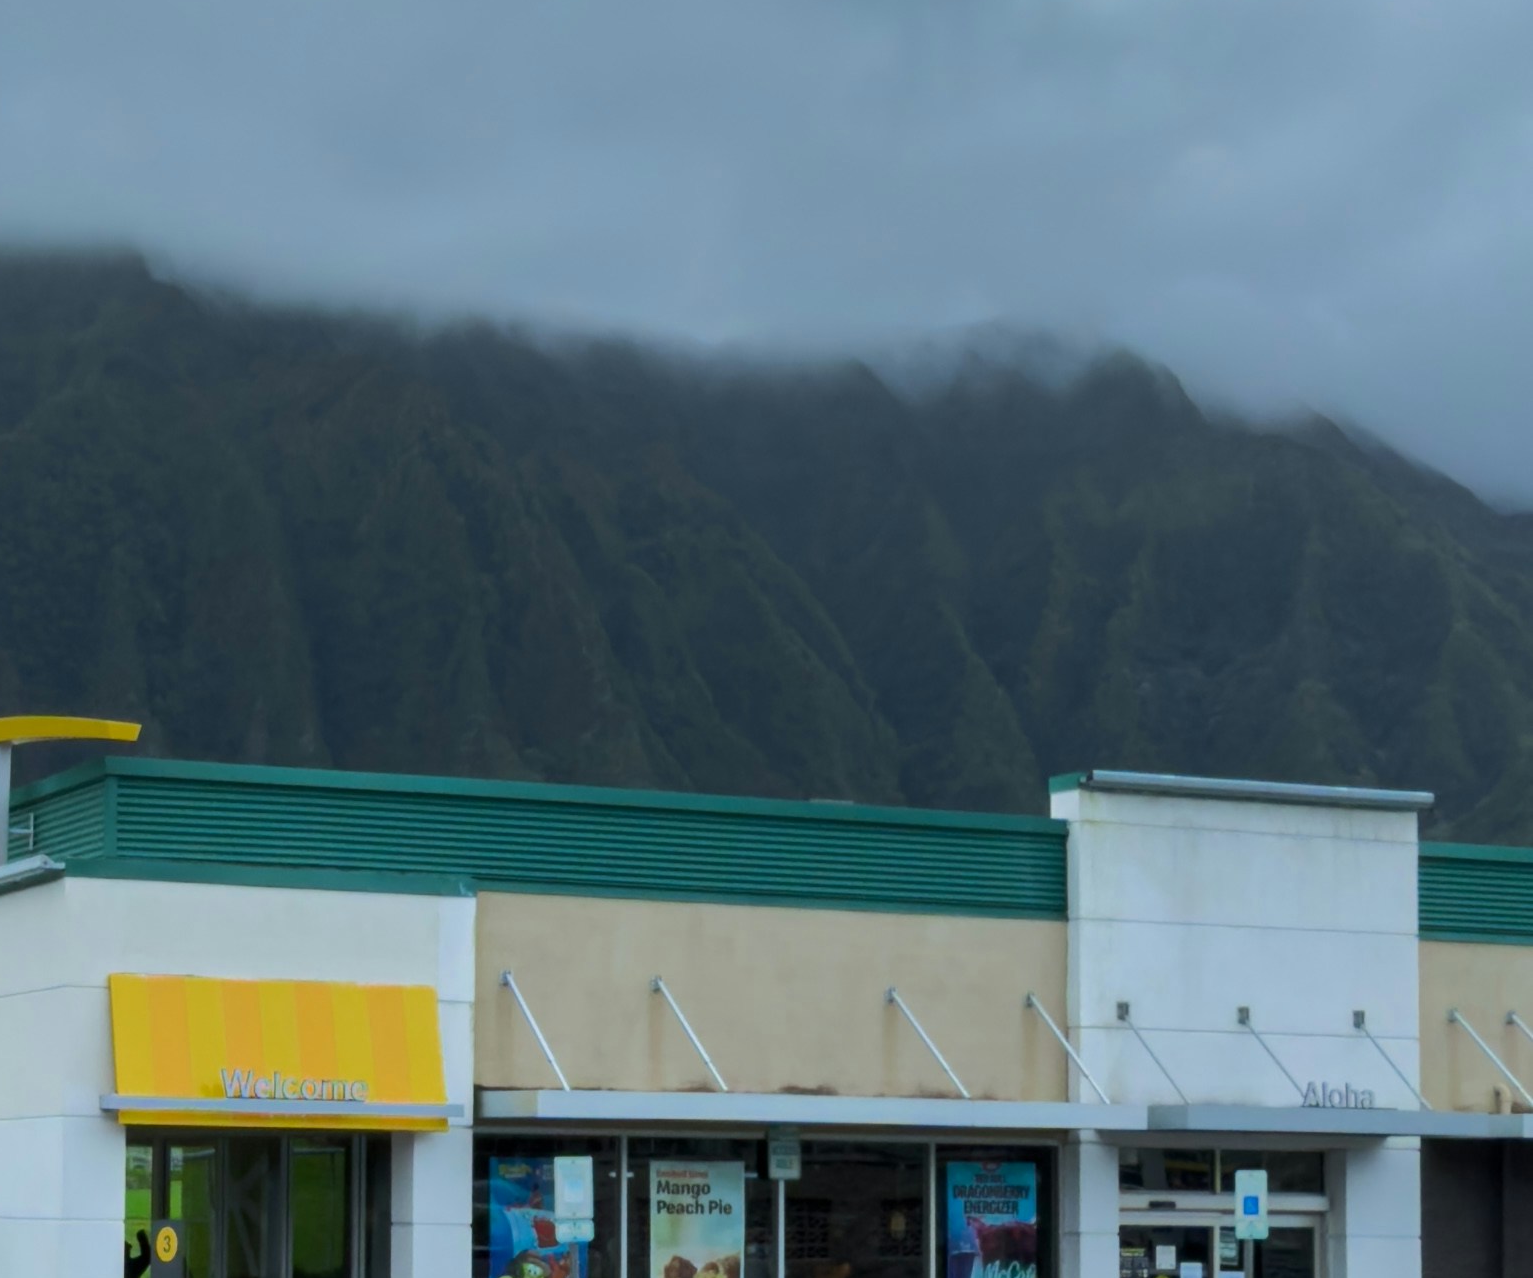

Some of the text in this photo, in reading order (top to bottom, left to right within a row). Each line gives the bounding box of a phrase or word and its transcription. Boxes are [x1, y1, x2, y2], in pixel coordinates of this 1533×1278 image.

[221, 1068, 368, 1102] Welcome
[1301, 1081, 1374, 1109] Aloha
[656, 1180, 711, 1198] Mango
[656, 1199, 733, 1215] Peach Pie
[163, 1235, 171, 1253] 3
